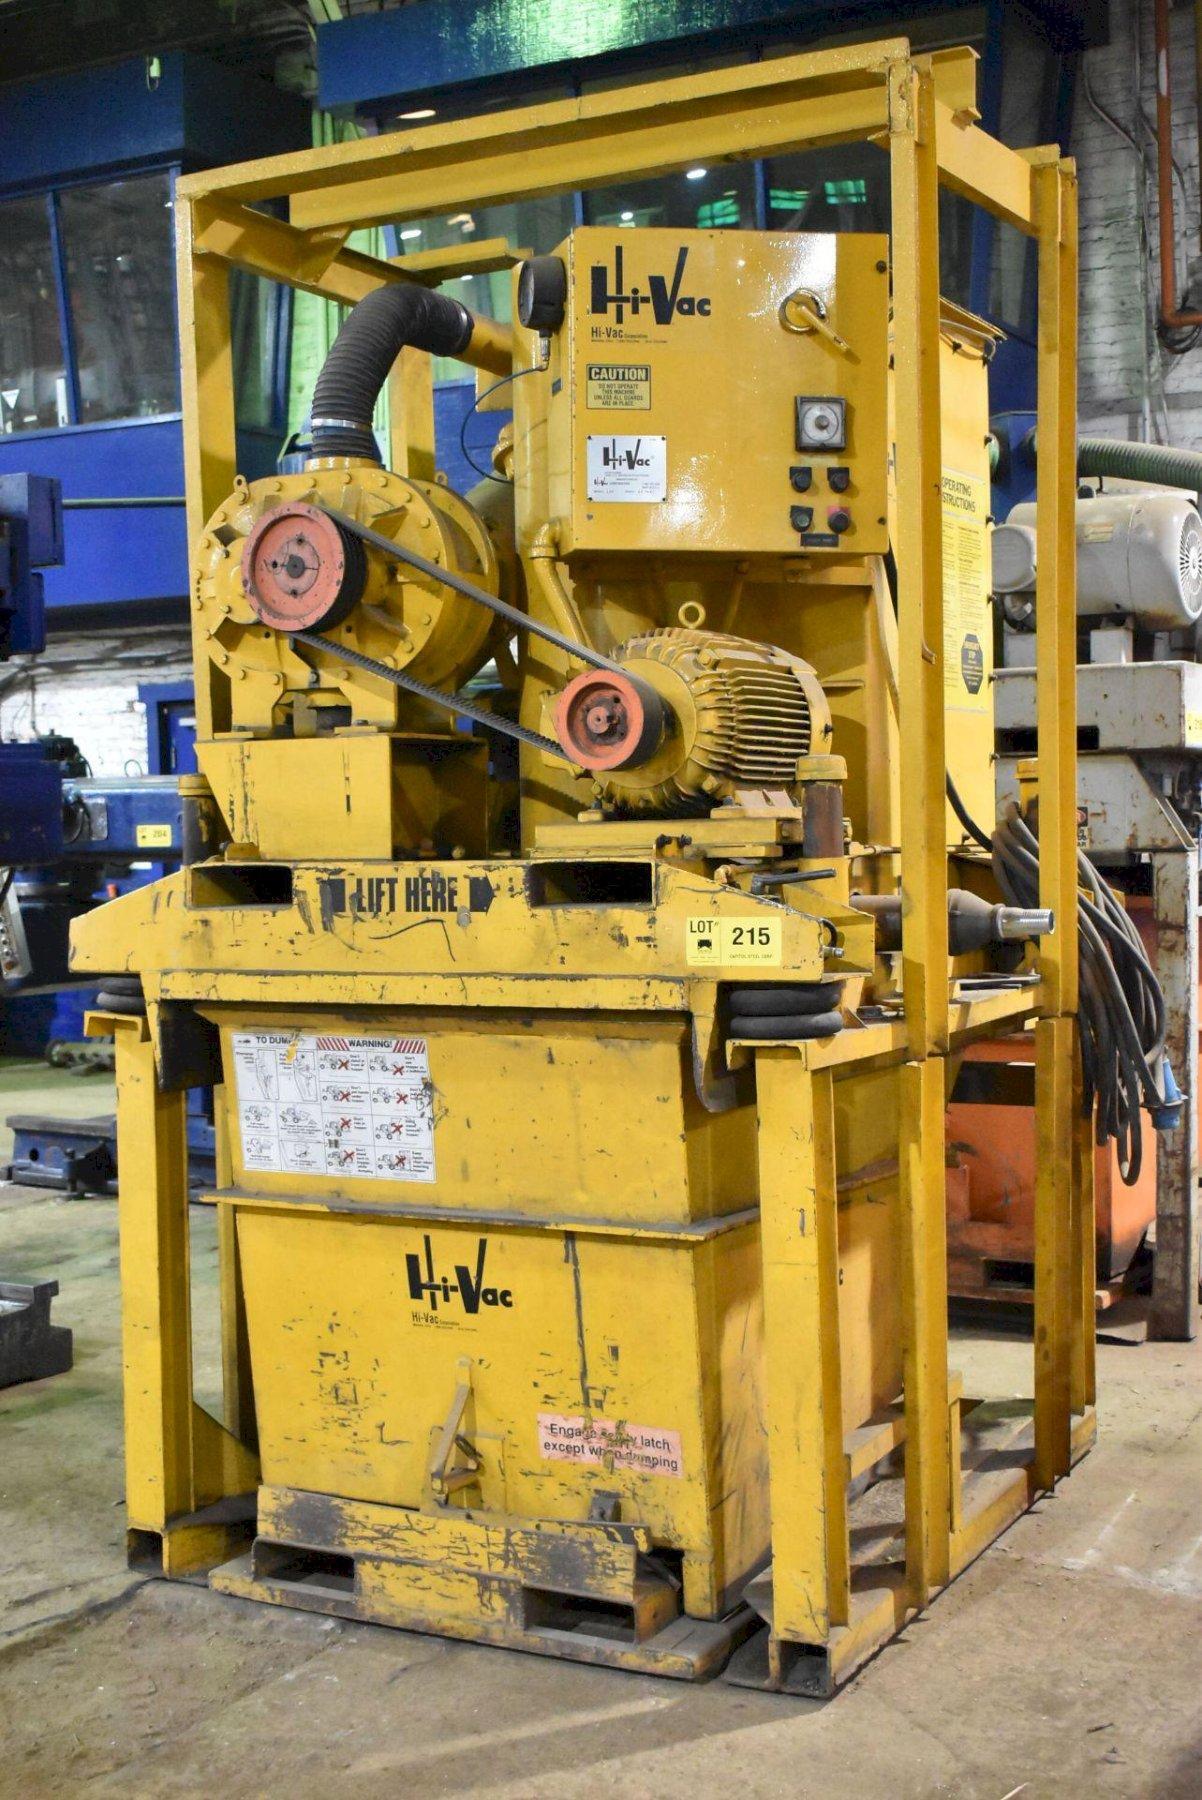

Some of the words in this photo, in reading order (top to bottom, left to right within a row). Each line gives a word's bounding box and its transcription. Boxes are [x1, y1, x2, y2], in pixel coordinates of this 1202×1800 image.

[591, 245, 712, 325] Hi-Vac
[591, 327, 624, 339] Hi-Vac
[591, 367, 647, 381] CAUTION
[603, 439, 650, 470] Hi-Vac
[942, 491, 976, 512] STRUCTIONS
[356, 877, 398, 912] LIFT
[405, 877, 458, 912] HERE
[732, 927, 770, 945] 215
[256, 1036, 267, 1044] TO
[269, 1036, 292, 1044] DUM
[349, 1040, 392, 1048] WARNING!
[405, 1234, 513, 1314] Hi-Vac
[412, 1312, 438, 1324] Hi-Vac
[544, 1441, 585, 1457] except
[641, 1435, 670, 1451] latch
